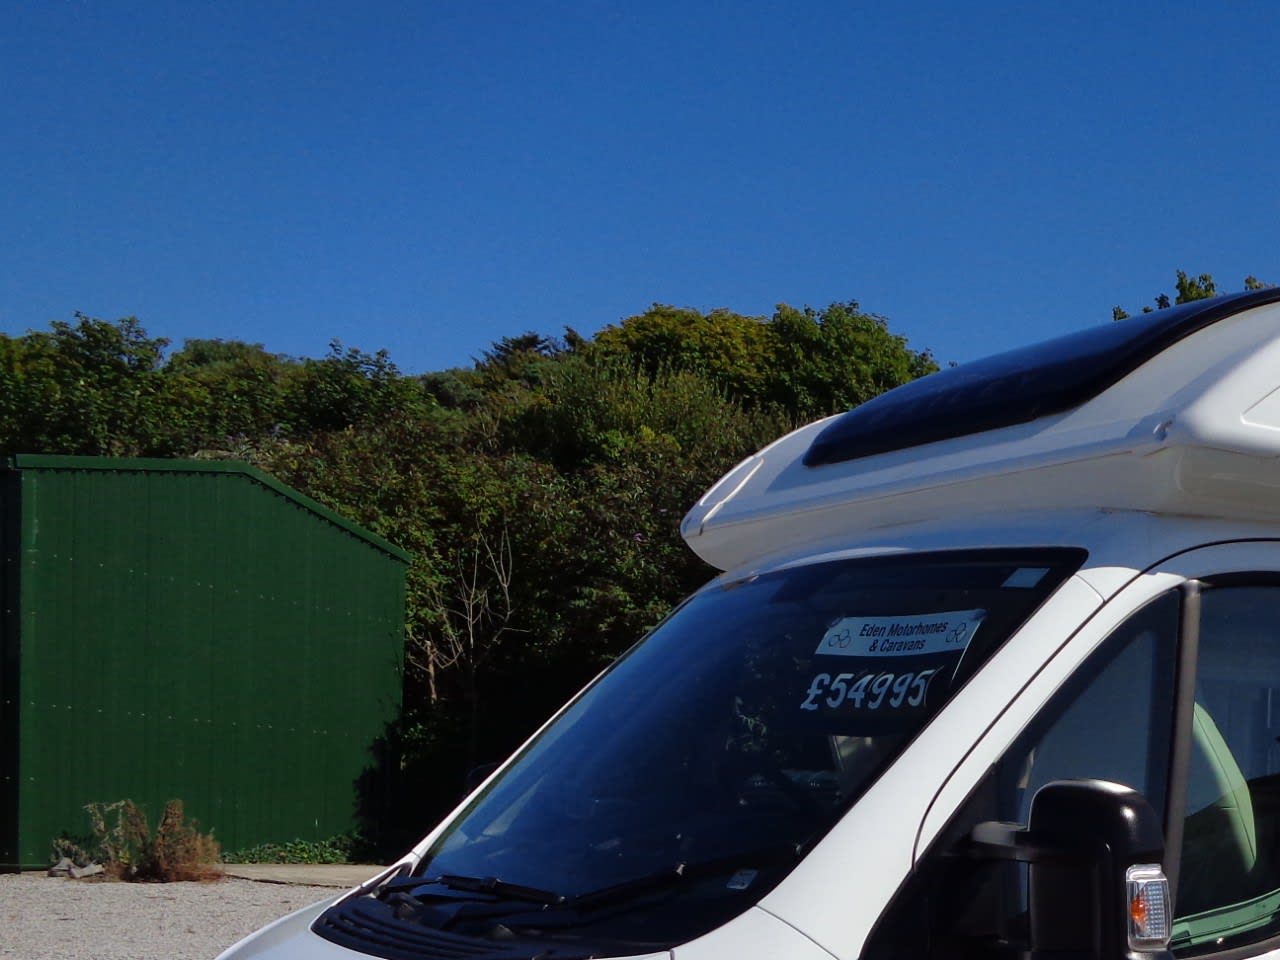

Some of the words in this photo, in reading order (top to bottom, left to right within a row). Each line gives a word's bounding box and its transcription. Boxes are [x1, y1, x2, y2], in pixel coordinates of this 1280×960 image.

[858, 622, 886, 638] Eden
[886, 620, 949, 637] Motorhomes
[868, 640, 878, 652] &
[879, 637, 926, 652] Caravans
[799, 669, 937, 711] £54995
